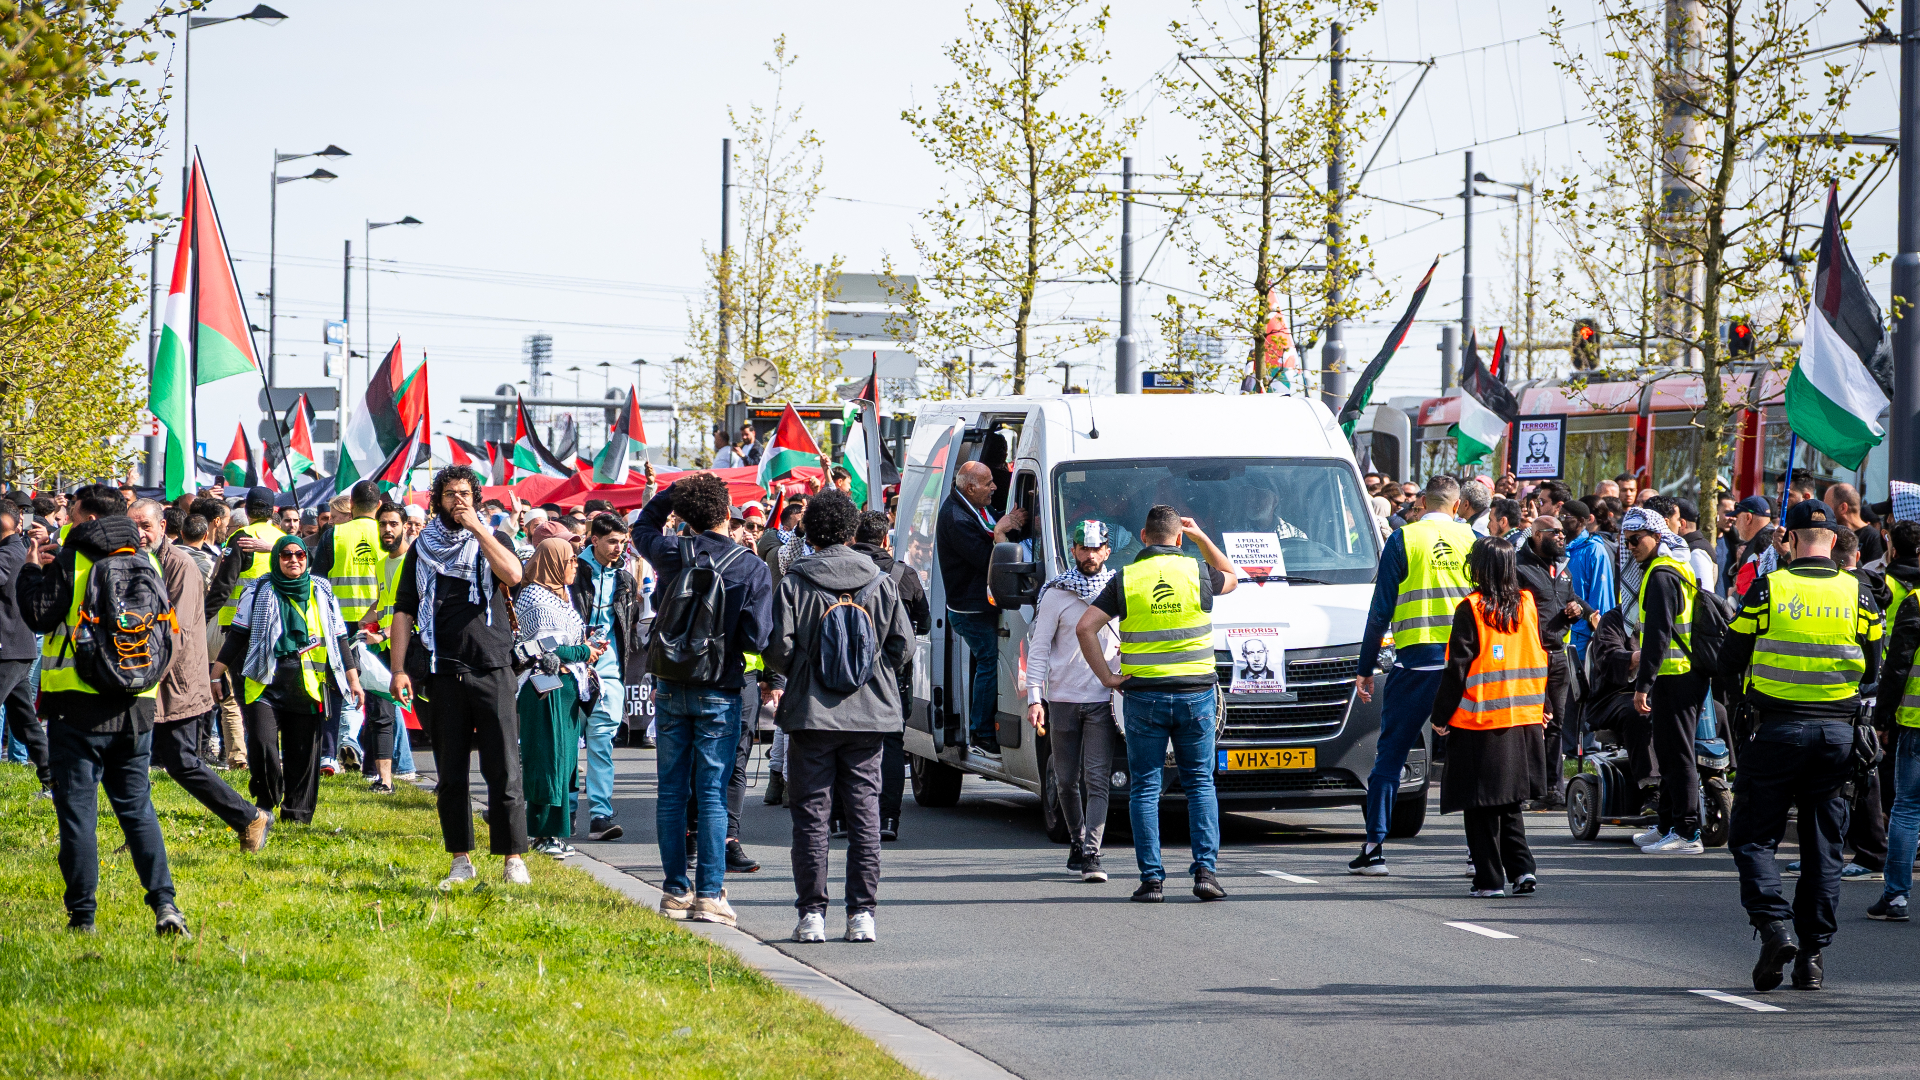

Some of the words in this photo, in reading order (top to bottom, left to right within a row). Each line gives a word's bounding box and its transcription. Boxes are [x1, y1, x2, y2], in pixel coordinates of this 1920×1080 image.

[1151, 602, 1182, 610] Moskee
[1777, 598, 1851, 620] POLITIE
[627, 700, 643, 716] OR
[646, 700, 656, 716] G
[1235, 751, 1308, 767] VHX-19-T
